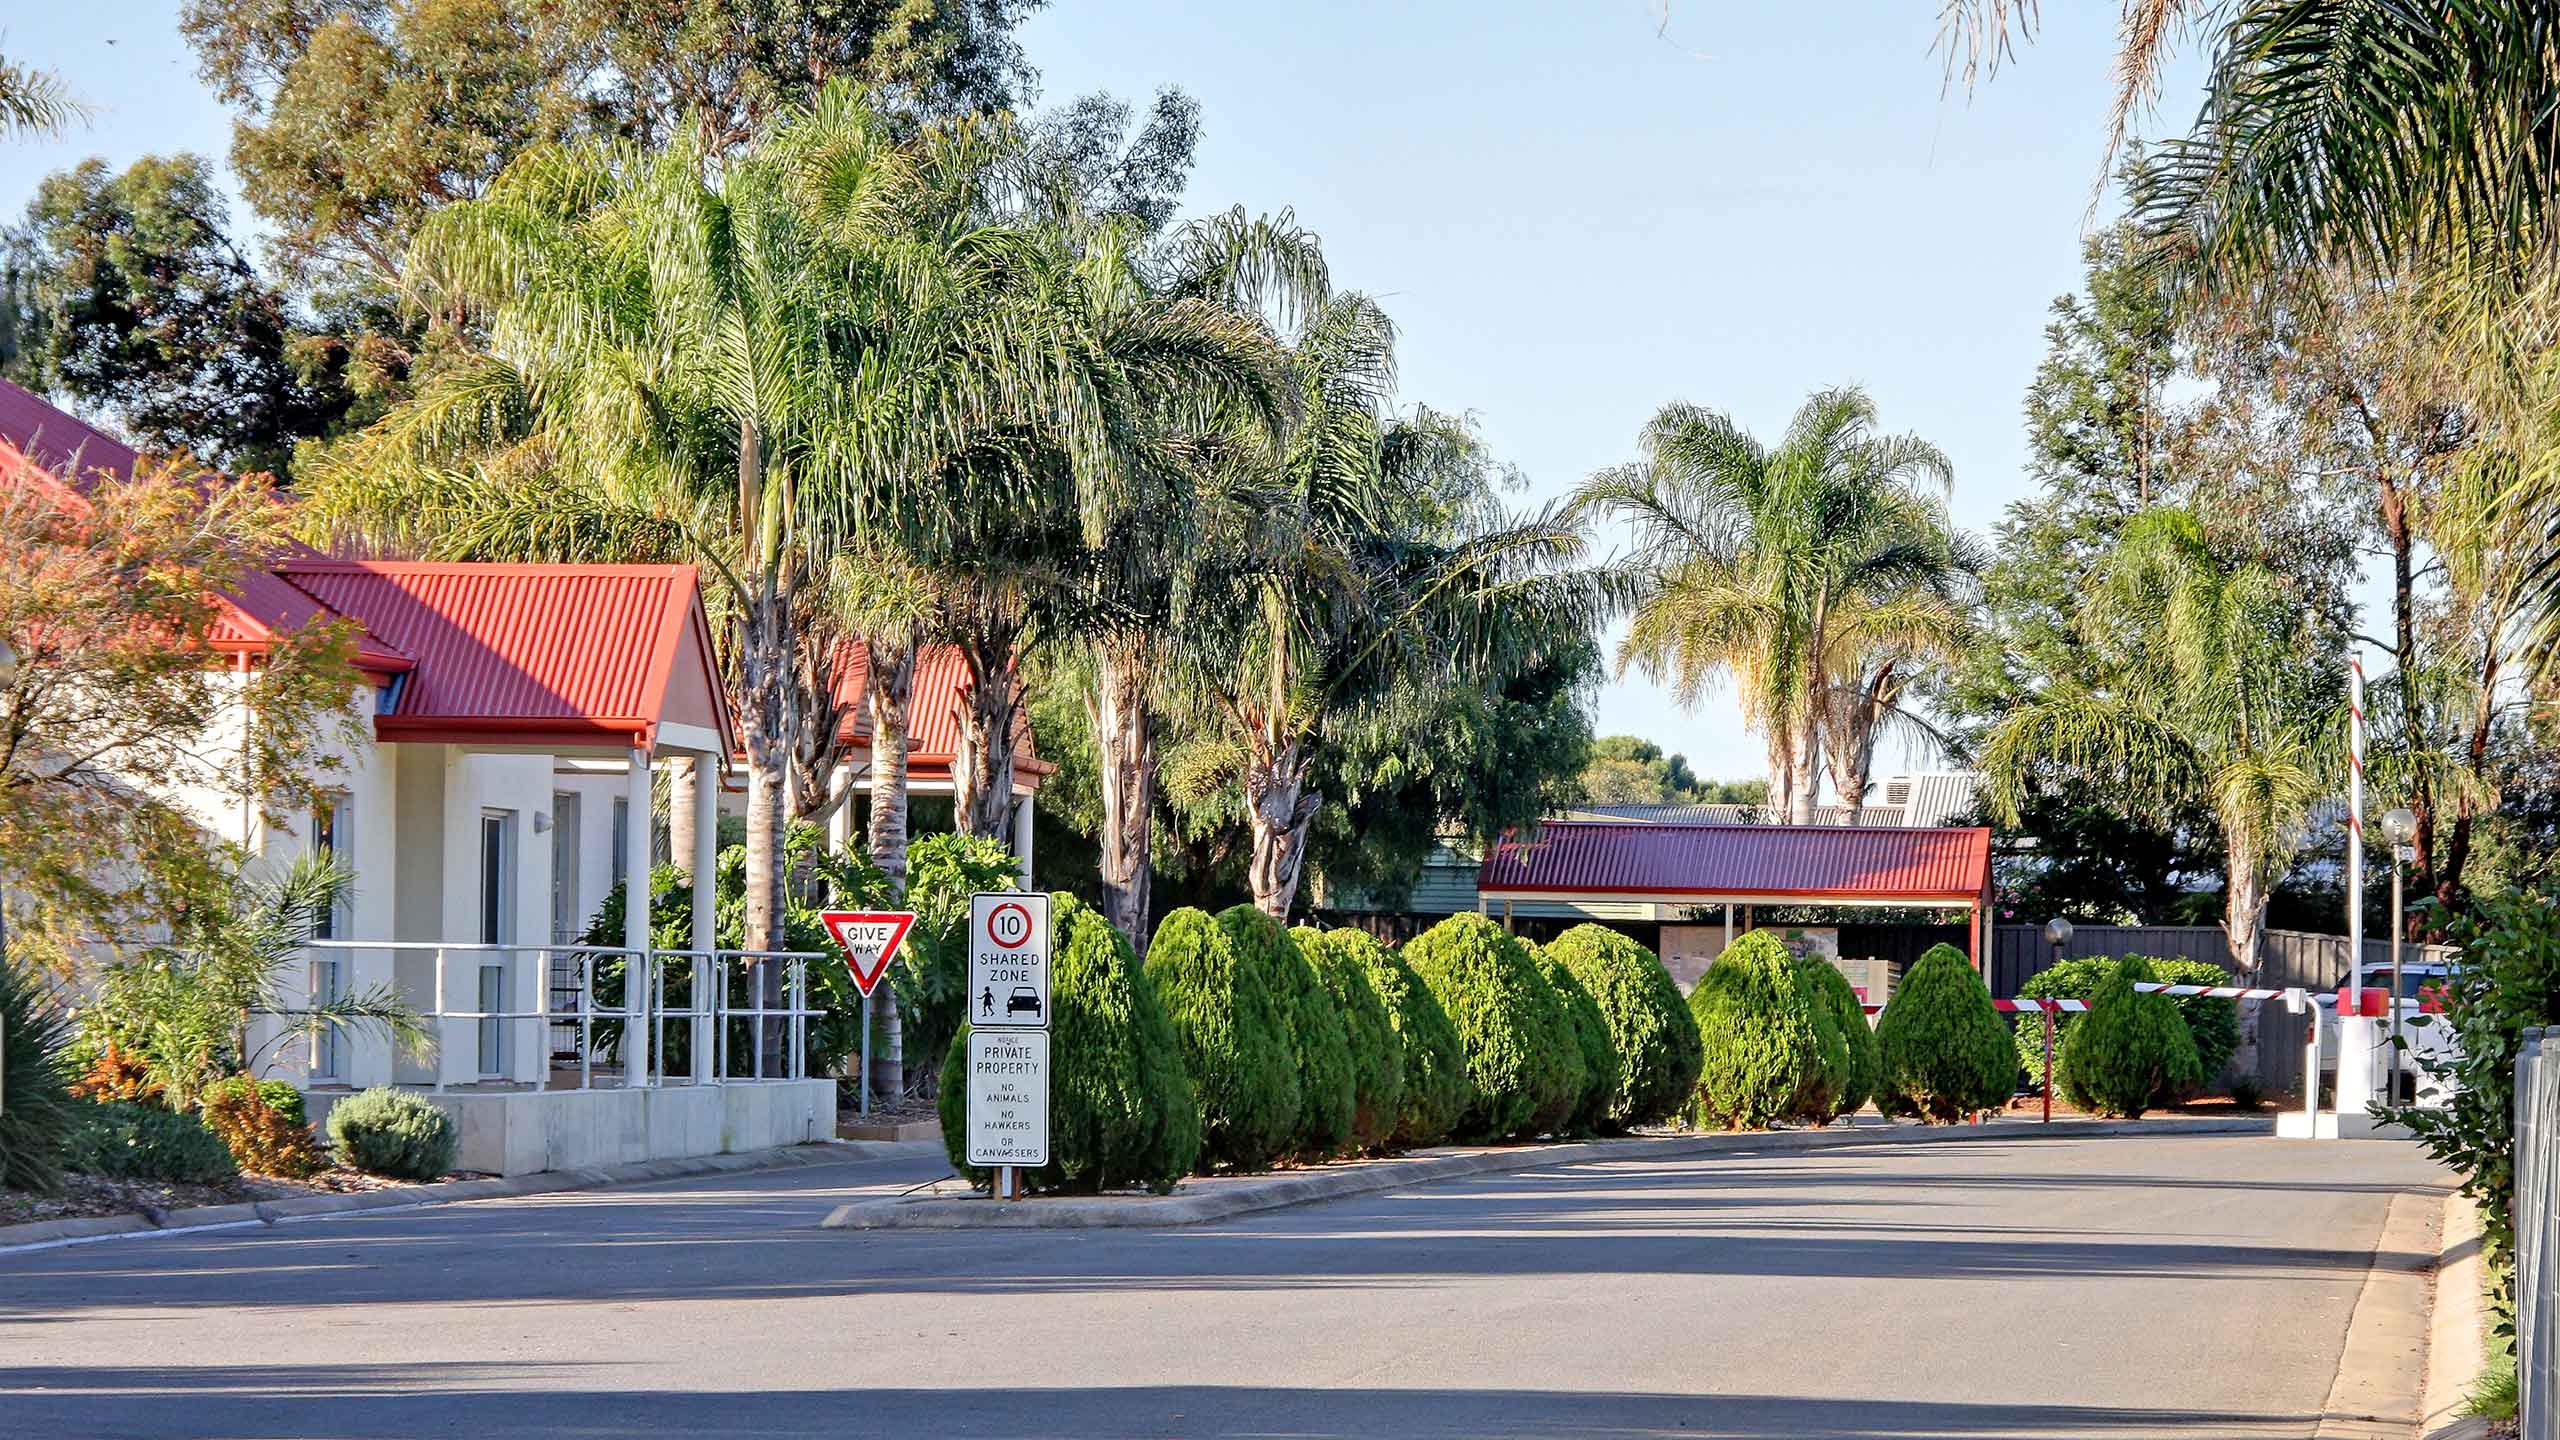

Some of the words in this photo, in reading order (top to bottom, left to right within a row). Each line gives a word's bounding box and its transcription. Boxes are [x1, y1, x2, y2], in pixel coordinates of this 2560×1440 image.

[1000, 916, 1020, 935] 10
[847, 927, 887, 941] GIVE
[854, 943, 882, 954] WAY
[980, 953, 1040, 966] SHARED
[990, 970, 1029, 982] ZONE
[984, 1047, 1032, 1059] PRIVATE
[976, 1062, 1039, 1074] PROPERTY
[1001, 1083, 1015, 1092] NO
[986, 1094, 1030, 1103] ANIMALS
[1001, 1110, 1014, 1119] NO
[984, 1121, 1031, 1130] HAWKERS
[1001, 1137, 1014, 1147] OR
[975, 1149, 1039, 1158] CANVASSERS
